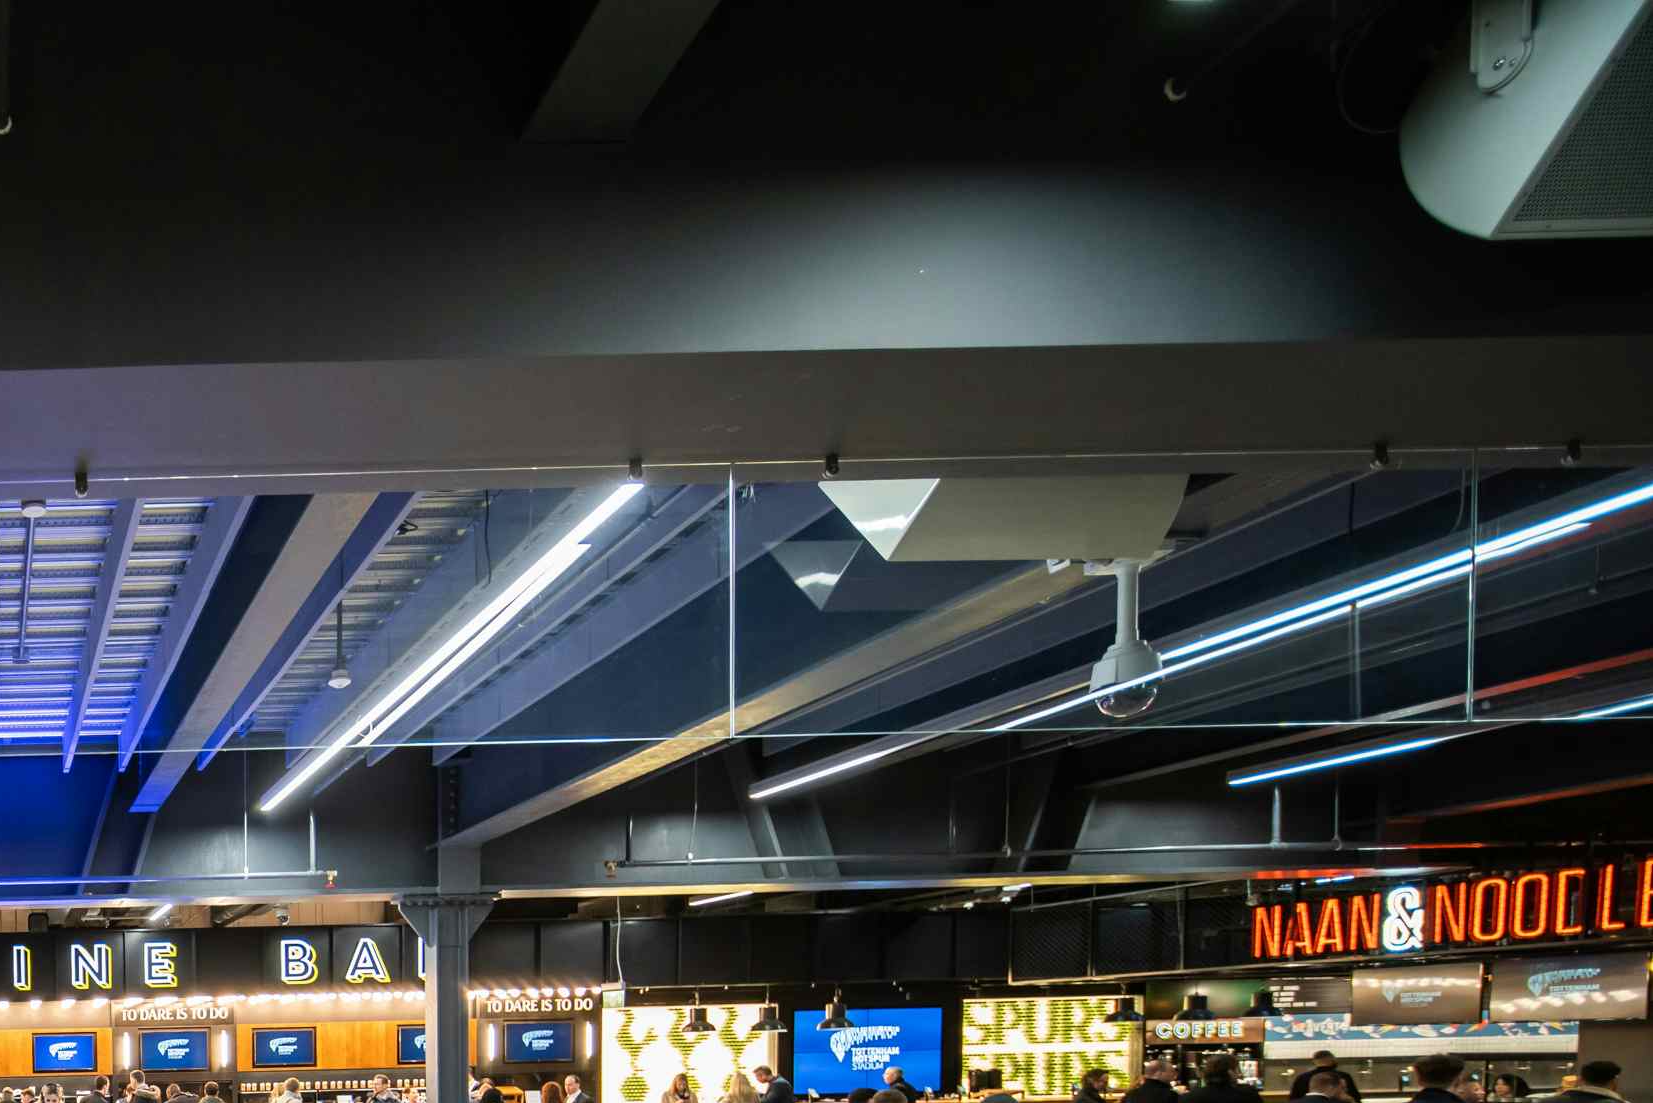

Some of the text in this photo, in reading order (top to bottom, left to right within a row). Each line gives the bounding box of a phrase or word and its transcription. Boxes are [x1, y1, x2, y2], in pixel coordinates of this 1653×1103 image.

[1252, 893, 1381, 958] NAAN
[280, 936, 426, 985] BA
[486, 998, 593, 1013] TO DARE IS TO DO
[122, 1007, 228, 1021] TO DARE IS TO DO
[1156, 1021, 1244, 1040] COFFEE
[850, 1047, 900, 1055] TOTTENHAM
[852, 1062, 884, 1071] STADIUM
